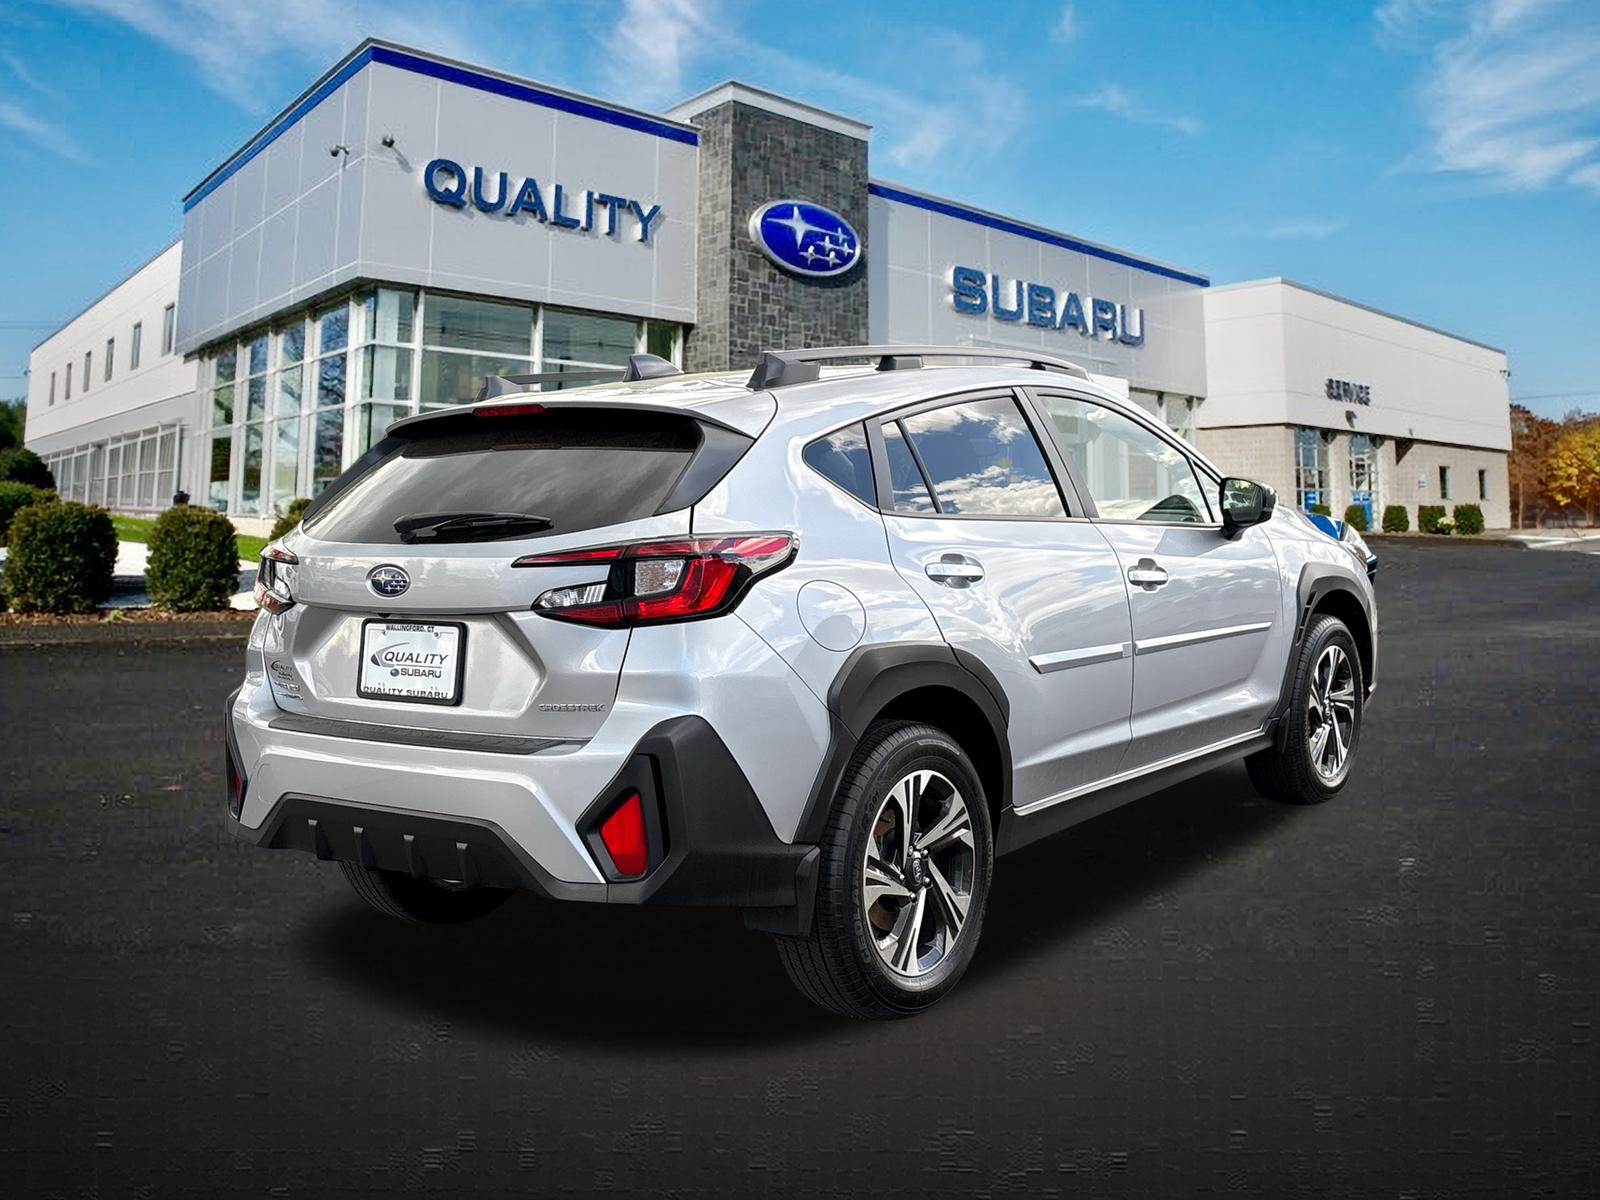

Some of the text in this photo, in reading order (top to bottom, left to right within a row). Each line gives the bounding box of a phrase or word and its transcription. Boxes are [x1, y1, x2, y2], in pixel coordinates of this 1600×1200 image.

[424, 158, 661, 242] QUALITY
[950, 265, 1145, 346] SUBARU
[1326, 378, 1371, 406] SERVICE
[384, 651, 448, 664] QUALITY
[400, 668, 442, 678] SUBARU
[363, 686, 448, 699] QUALITY SUBARU
[538, 703, 606, 712] CROSSTREK
